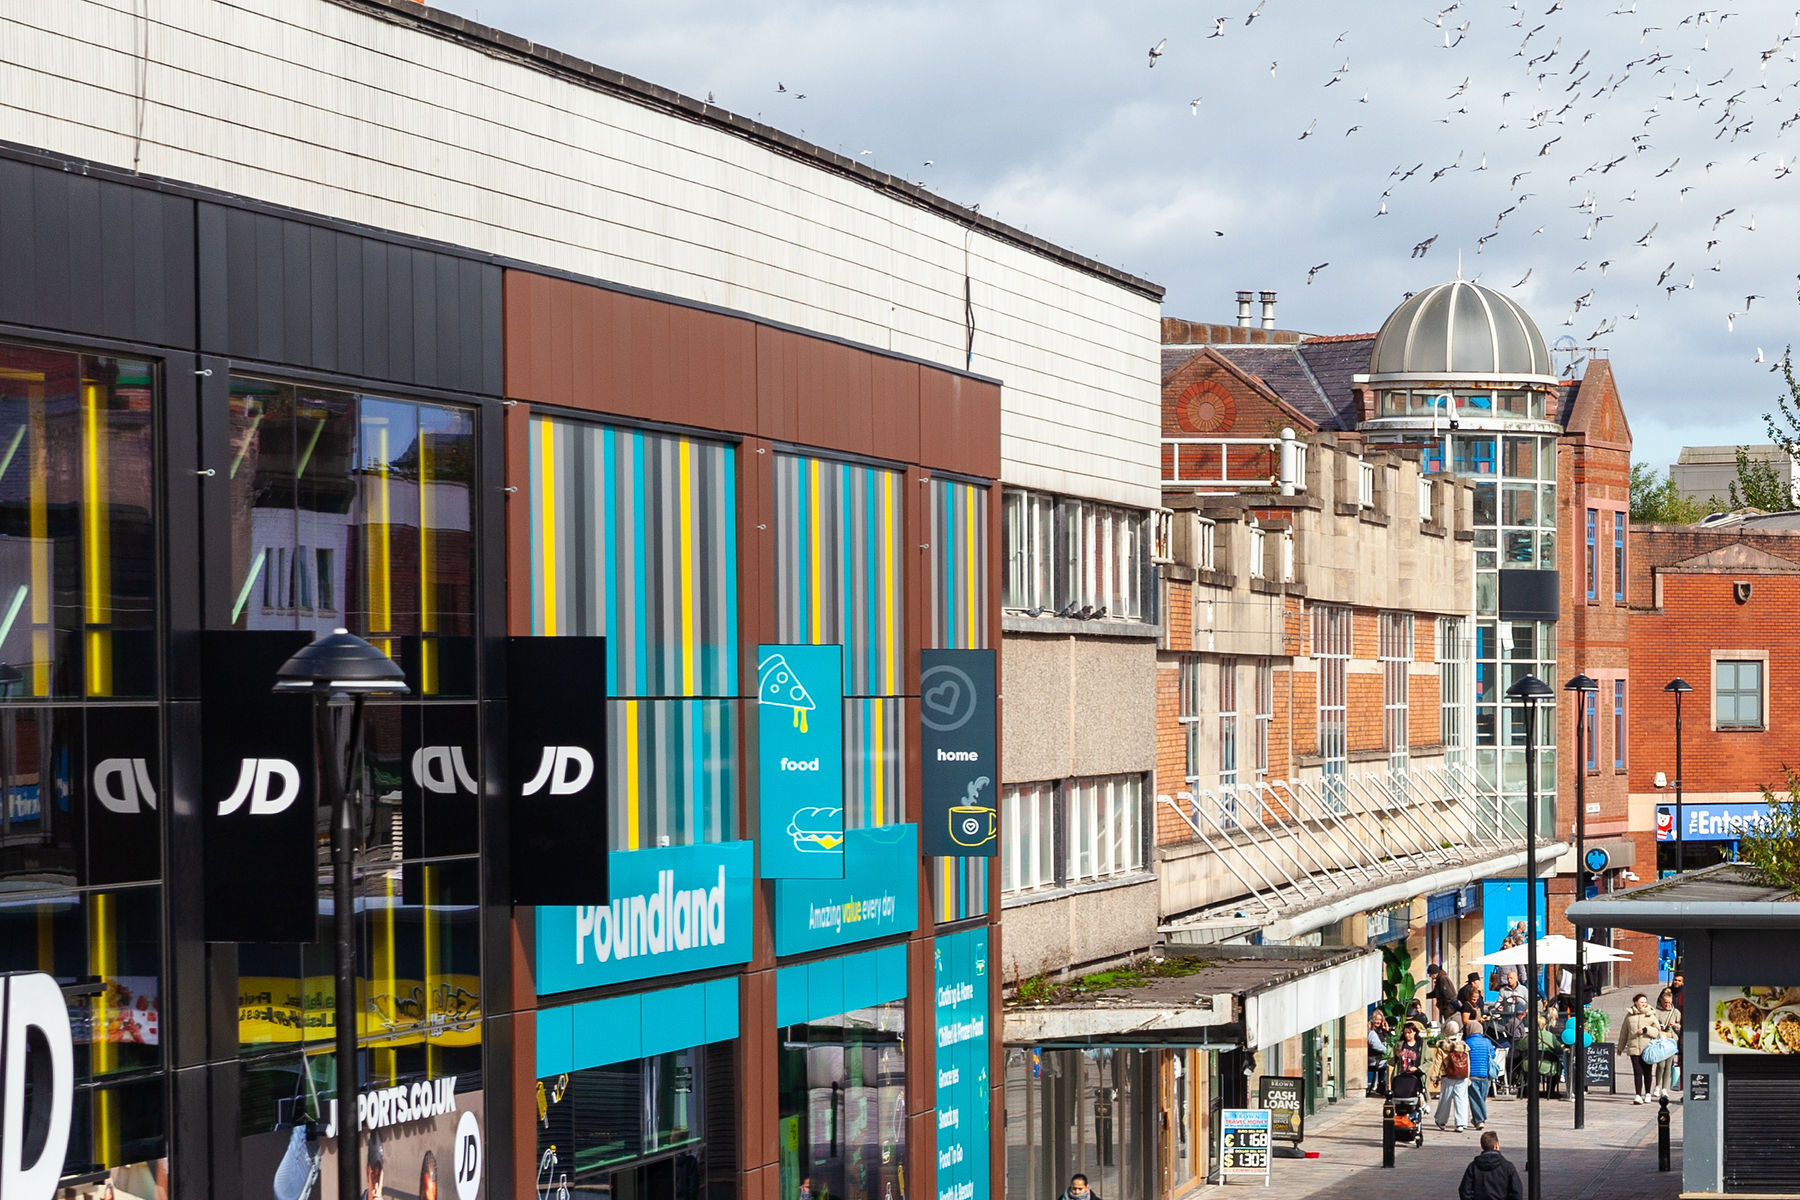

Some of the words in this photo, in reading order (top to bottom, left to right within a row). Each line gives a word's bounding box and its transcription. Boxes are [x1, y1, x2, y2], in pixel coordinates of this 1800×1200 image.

[780, 757, 820, 772] food
[937, 748, 979, 762] home
[522, 746, 595, 797] JD
[217, 758, 300, 817] JD
[1688, 811, 1698, 835] The
[576, 864, 725, 965] Poundland
[809, 898, 841, 934] Amazing
[842, 895, 862, 924] value
[862, 898, 882, 926] every
[882, 889, 896, 923] day
[938, 984, 956, 1009] Clothing
[961, 982, 973, 1000] Home
[971, 1015, 984, 1037] Food
[938, 1065, 959, 1089] Groceries
[325, 1076, 457, 1138] JPORTS.CO.UK
[1263, 1100, 1300, 1110] LOANS
[1268, 1090, 1296, 1101] CASH
[938, 1105, 959, 1129] Snacking
[1225, 1133, 1235, 1147] €
[459, 1134, 478, 1184] JD
[939, 1149, 950, 1170] Food
[957, 1143, 963, 1163] Go
[1224, 1153, 1234, 1167] $
